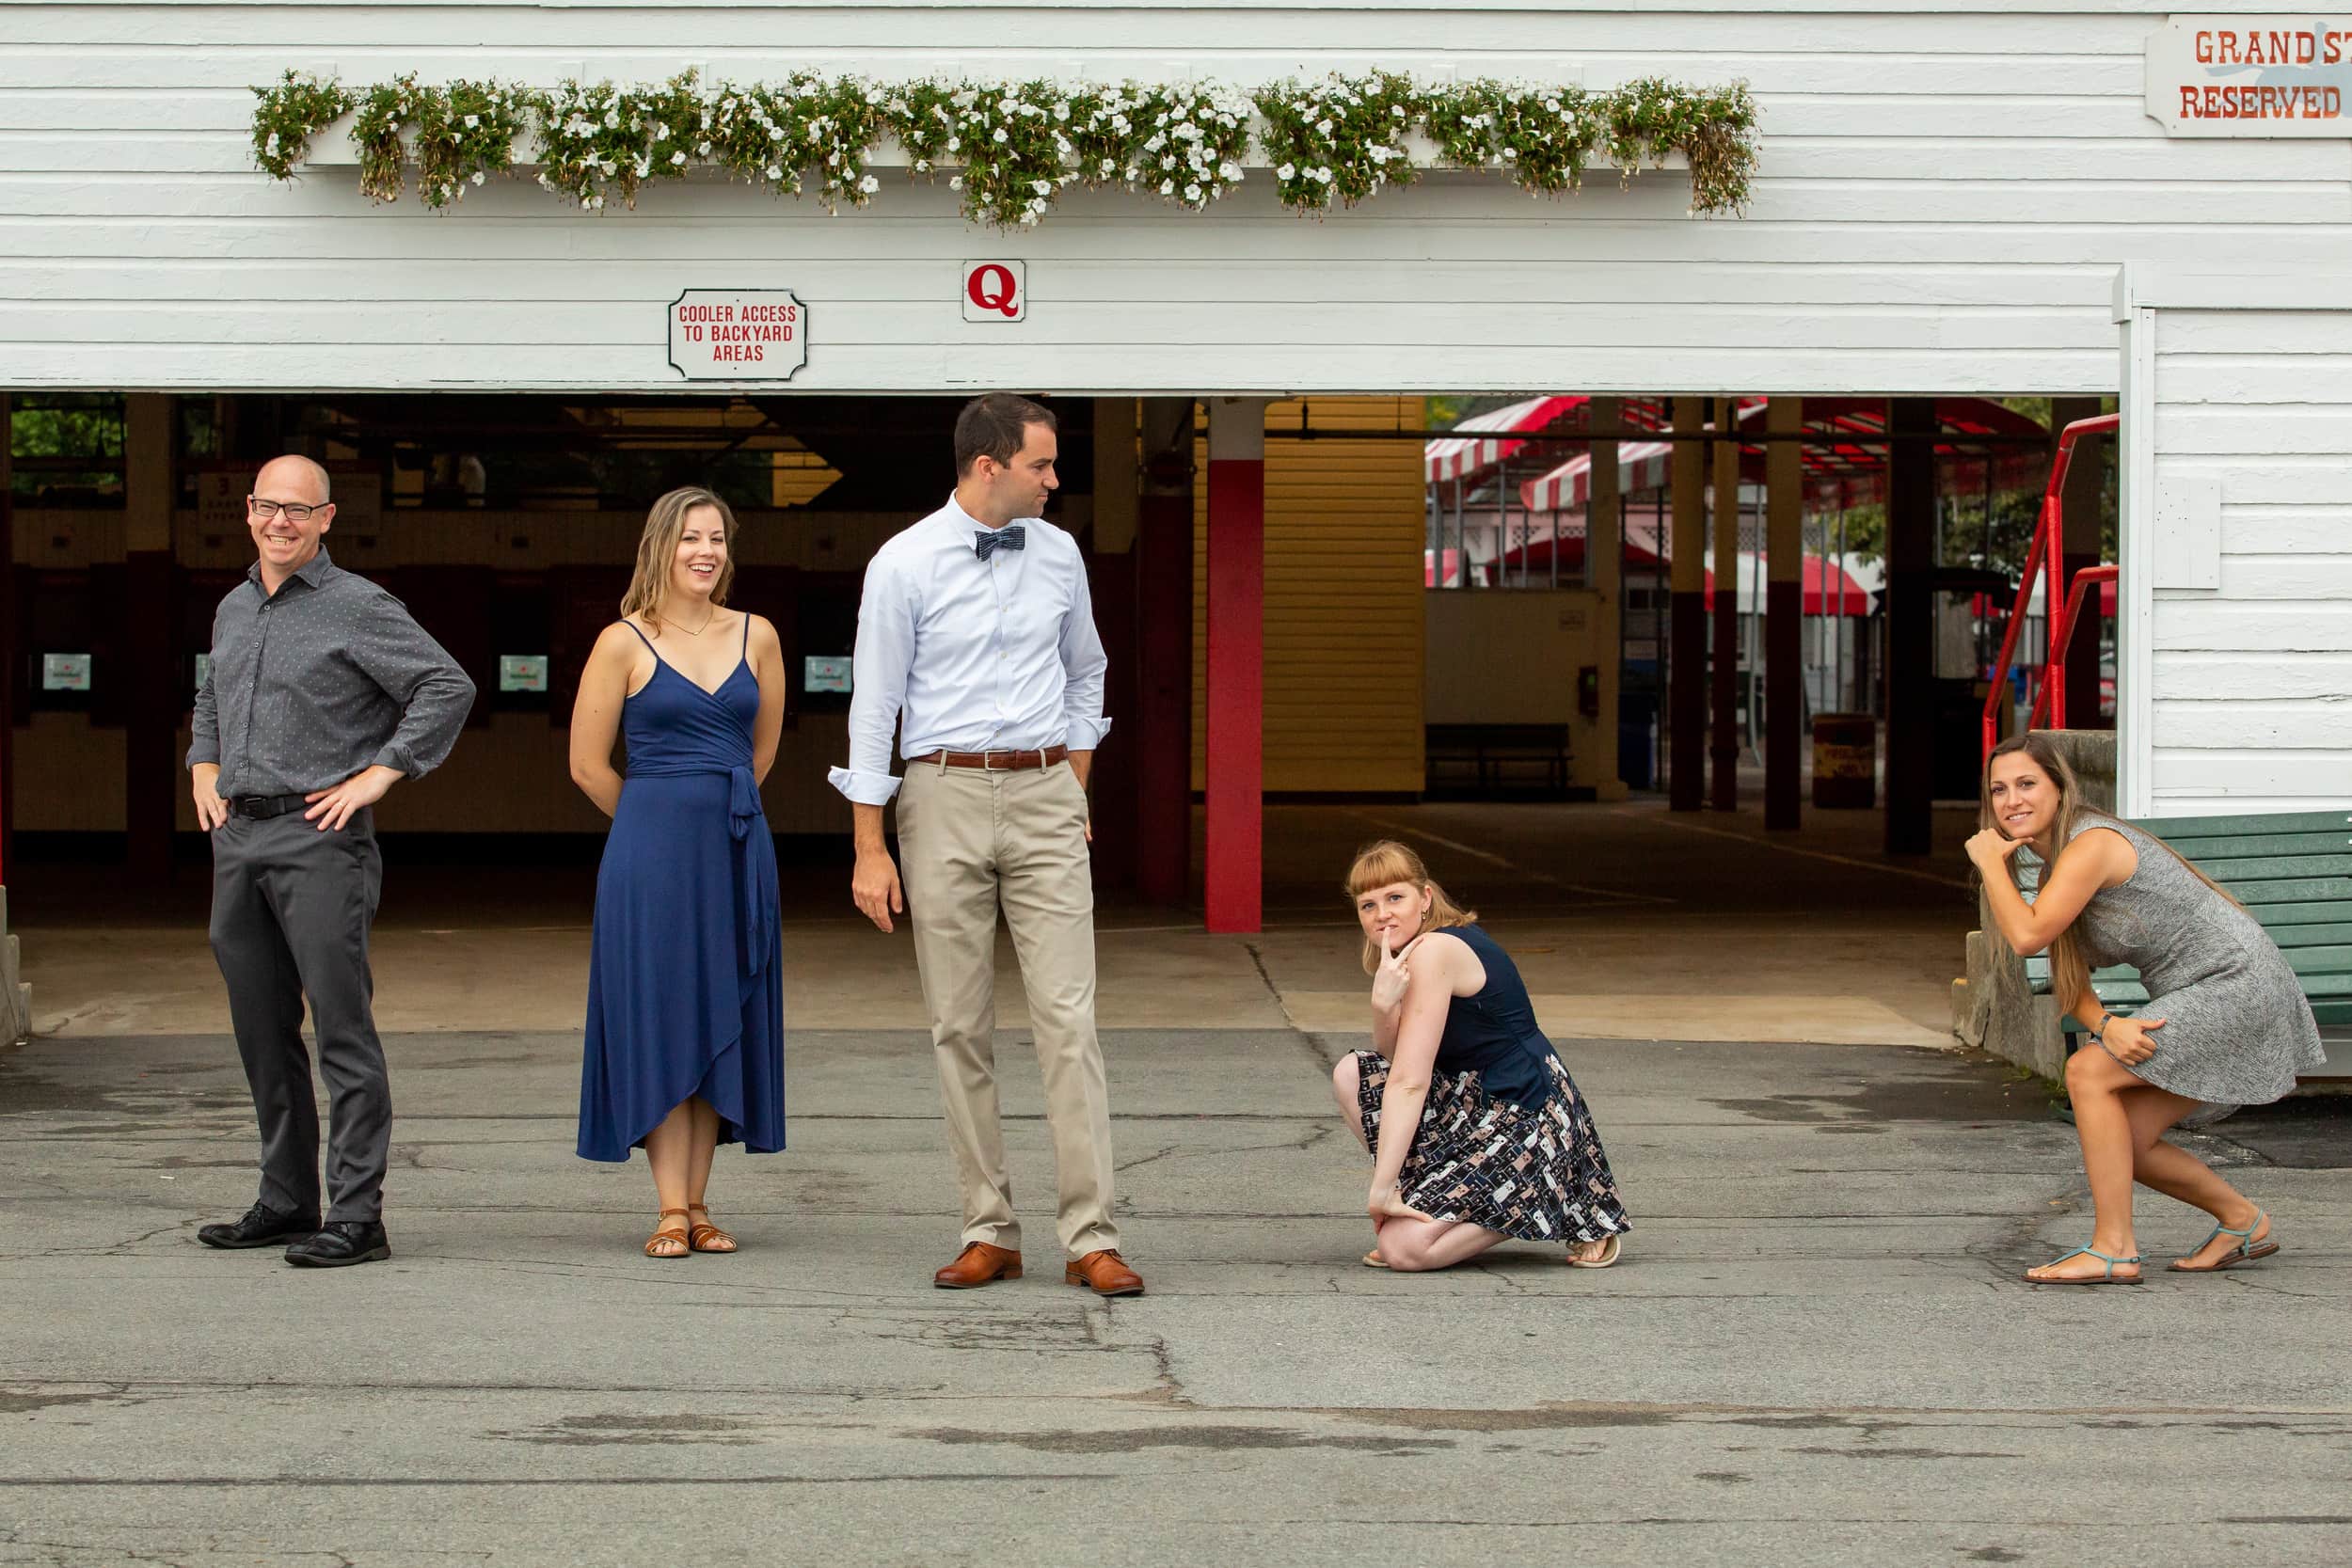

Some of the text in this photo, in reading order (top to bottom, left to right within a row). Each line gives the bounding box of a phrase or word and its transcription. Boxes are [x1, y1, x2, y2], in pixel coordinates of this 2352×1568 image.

[2179, 86, 2341, 119] RESERVED
[967, 263, 1019, 318] Q
[678, 306, 797, 323] COOLER ACCESS
[683, 325, 793, 342] TO BACKYARD
[712, 344, 764, 362] AREAS
